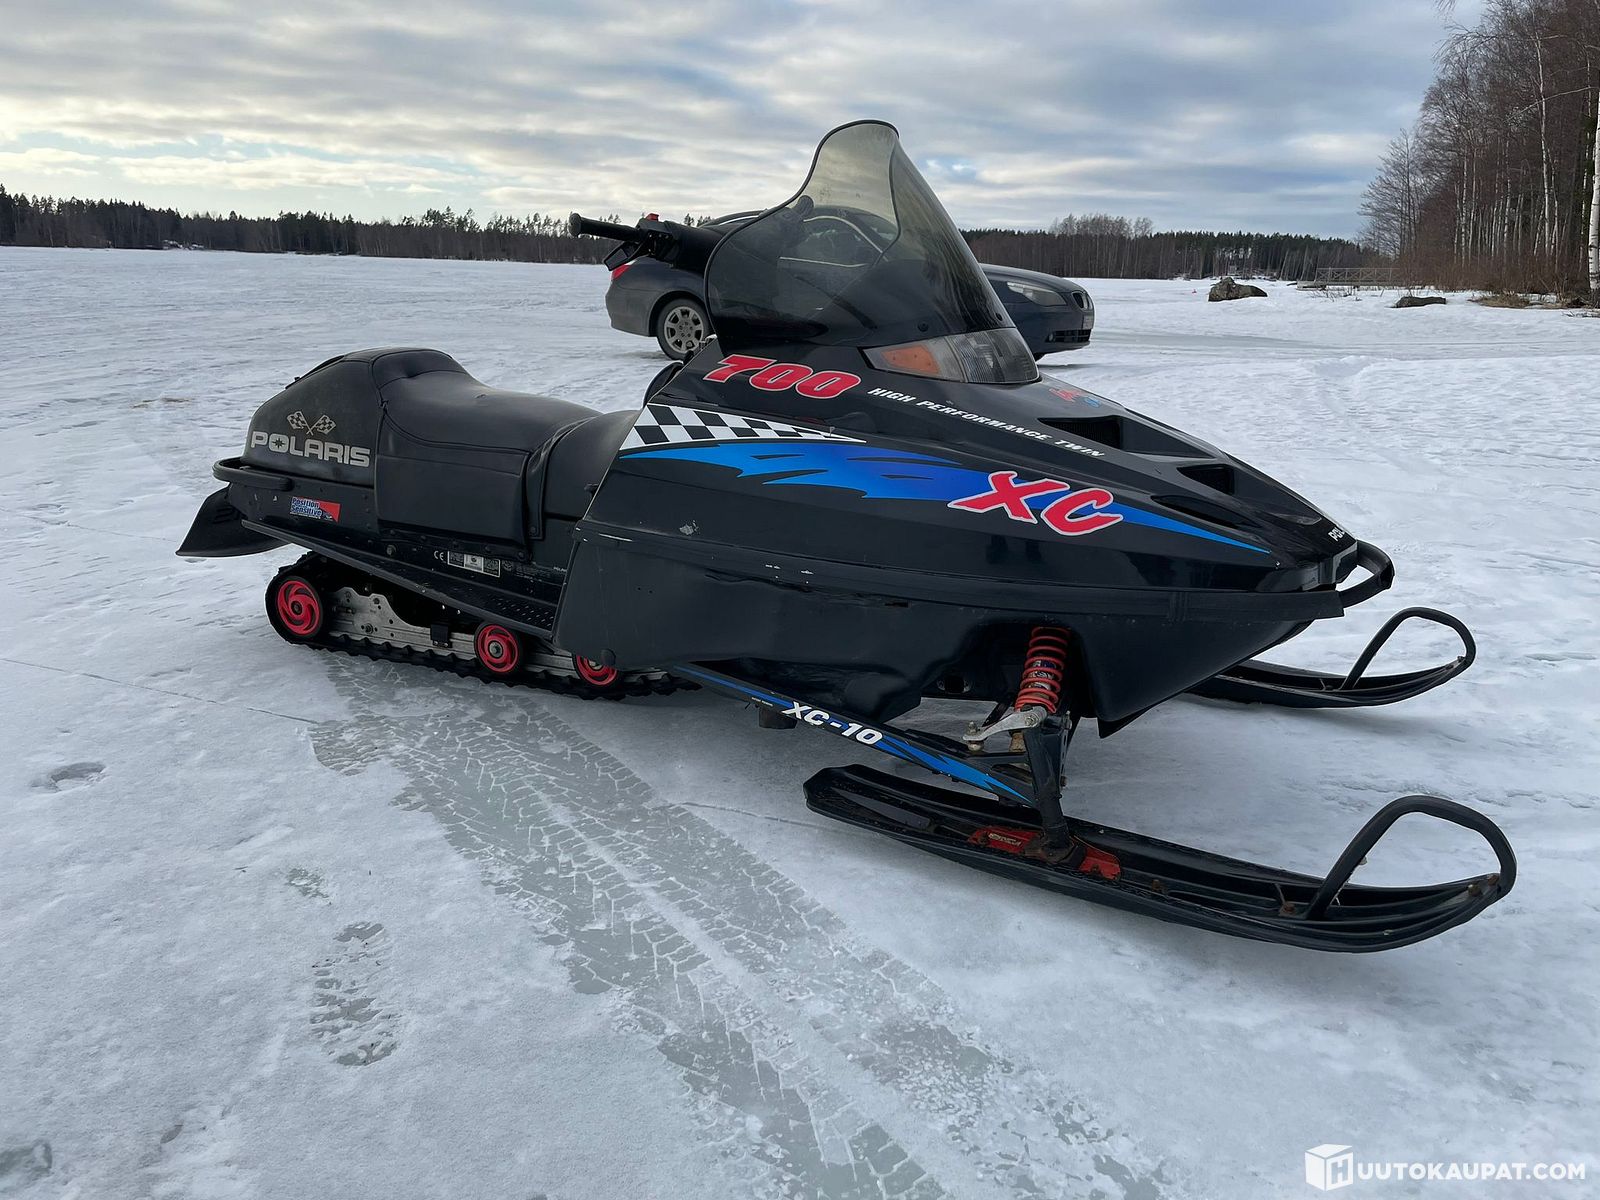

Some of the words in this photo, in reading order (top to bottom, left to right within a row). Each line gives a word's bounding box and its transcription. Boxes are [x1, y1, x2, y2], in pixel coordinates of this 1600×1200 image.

[703, 354, 862, 399] 700
[867, 387, 917, 404] HIGH
[918, 399, 1053, 442] PERFORMANCE
[1054, 438, 1105, 459] TWIN
[250, 430, 371, 468] POLARIS
[290, 504, 323, 517] Sensitive
[291, 496, 321, 509] Position
[947, 470, 1124, 537] XC
[781, 701, 883, 745] XC-10
